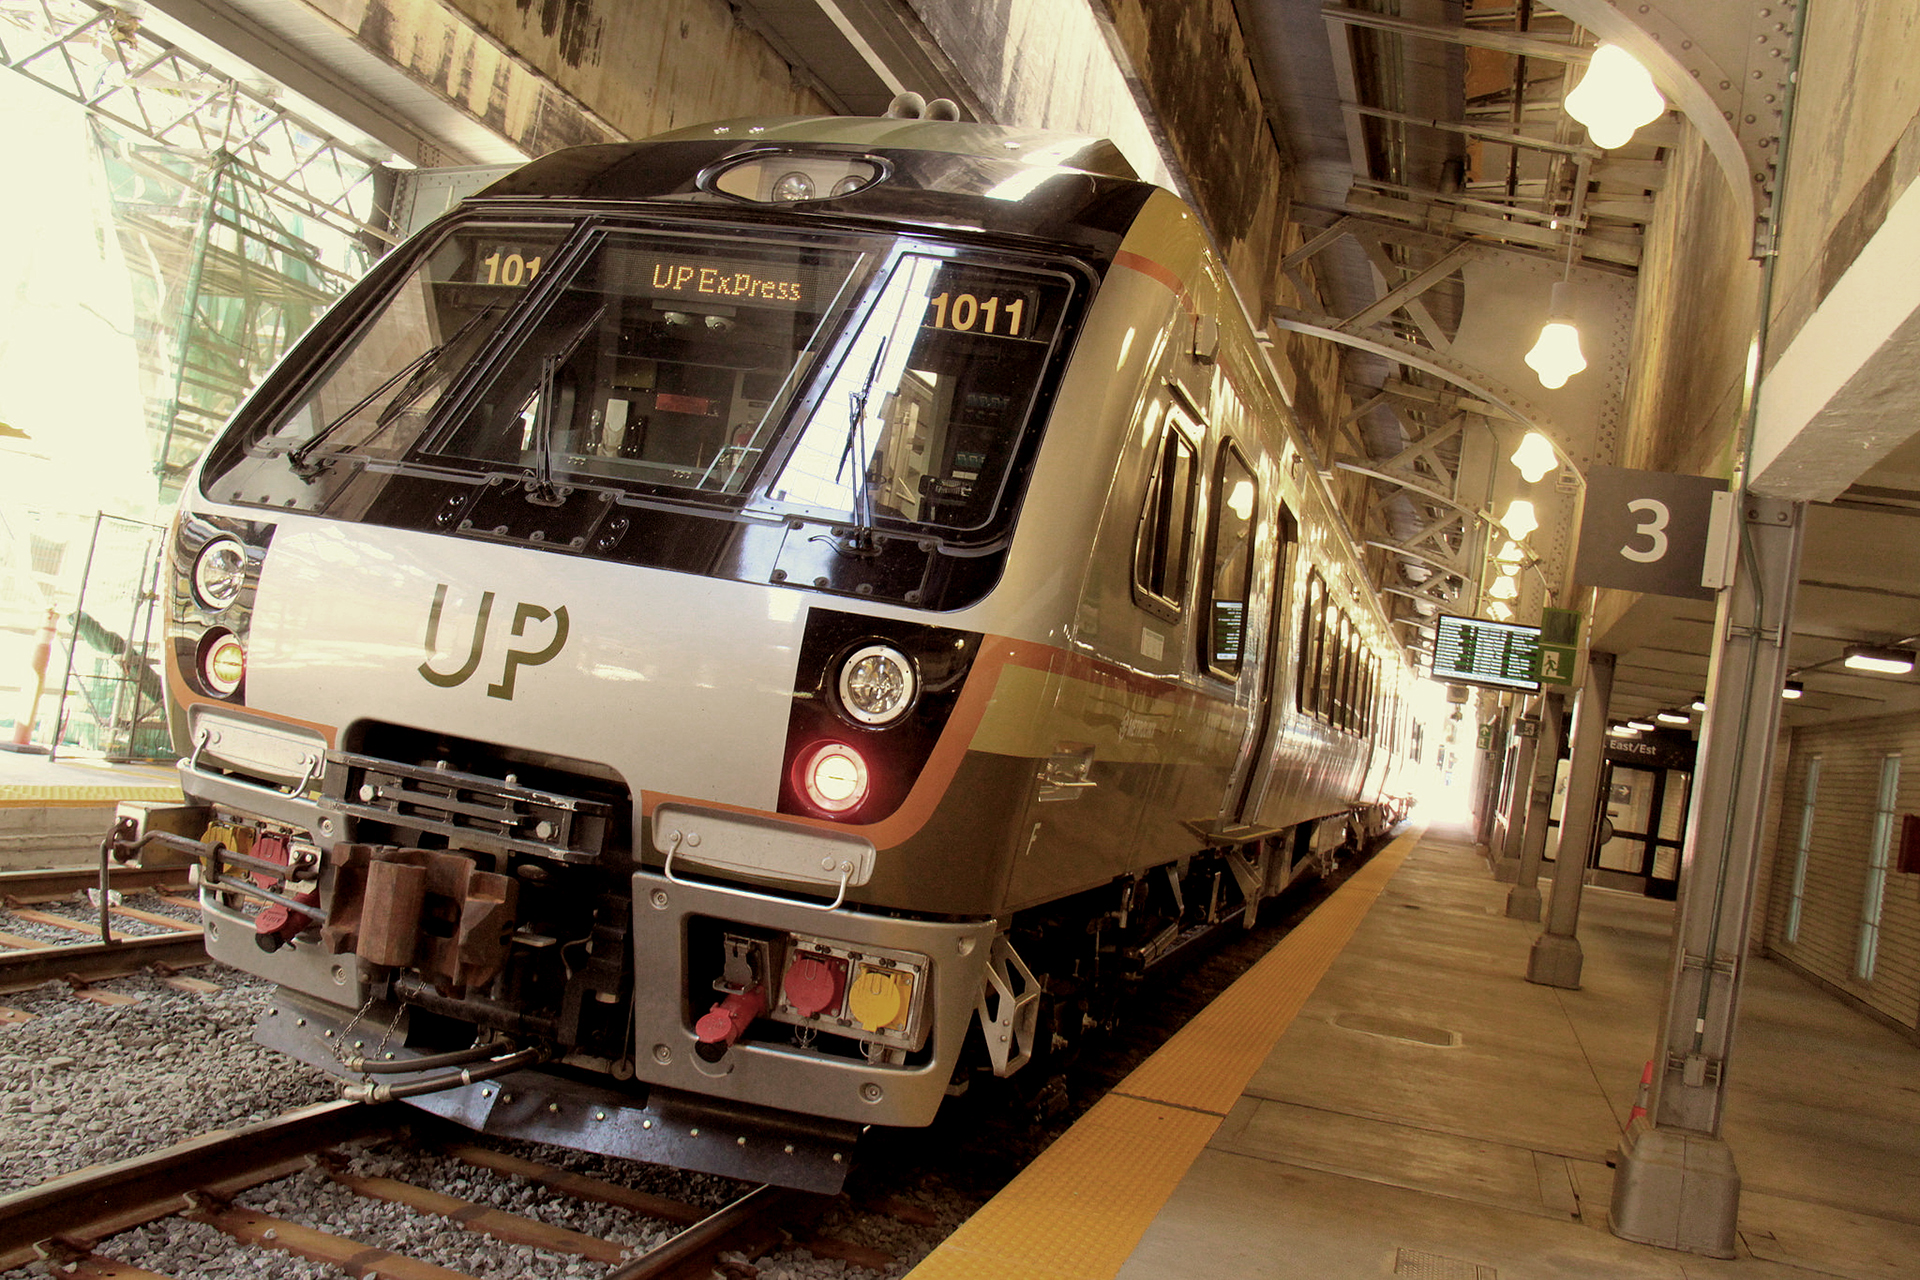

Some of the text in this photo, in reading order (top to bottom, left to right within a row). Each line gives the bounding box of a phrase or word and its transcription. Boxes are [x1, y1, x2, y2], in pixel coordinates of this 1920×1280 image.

[653, 264, 694, 290] UP
[931, 292, 1023, 335] 1011
[1620, 498, 1670, 563] 3
[418, 584, 570, 700] UP
[1610, 740, 1657, 755] East/Est
